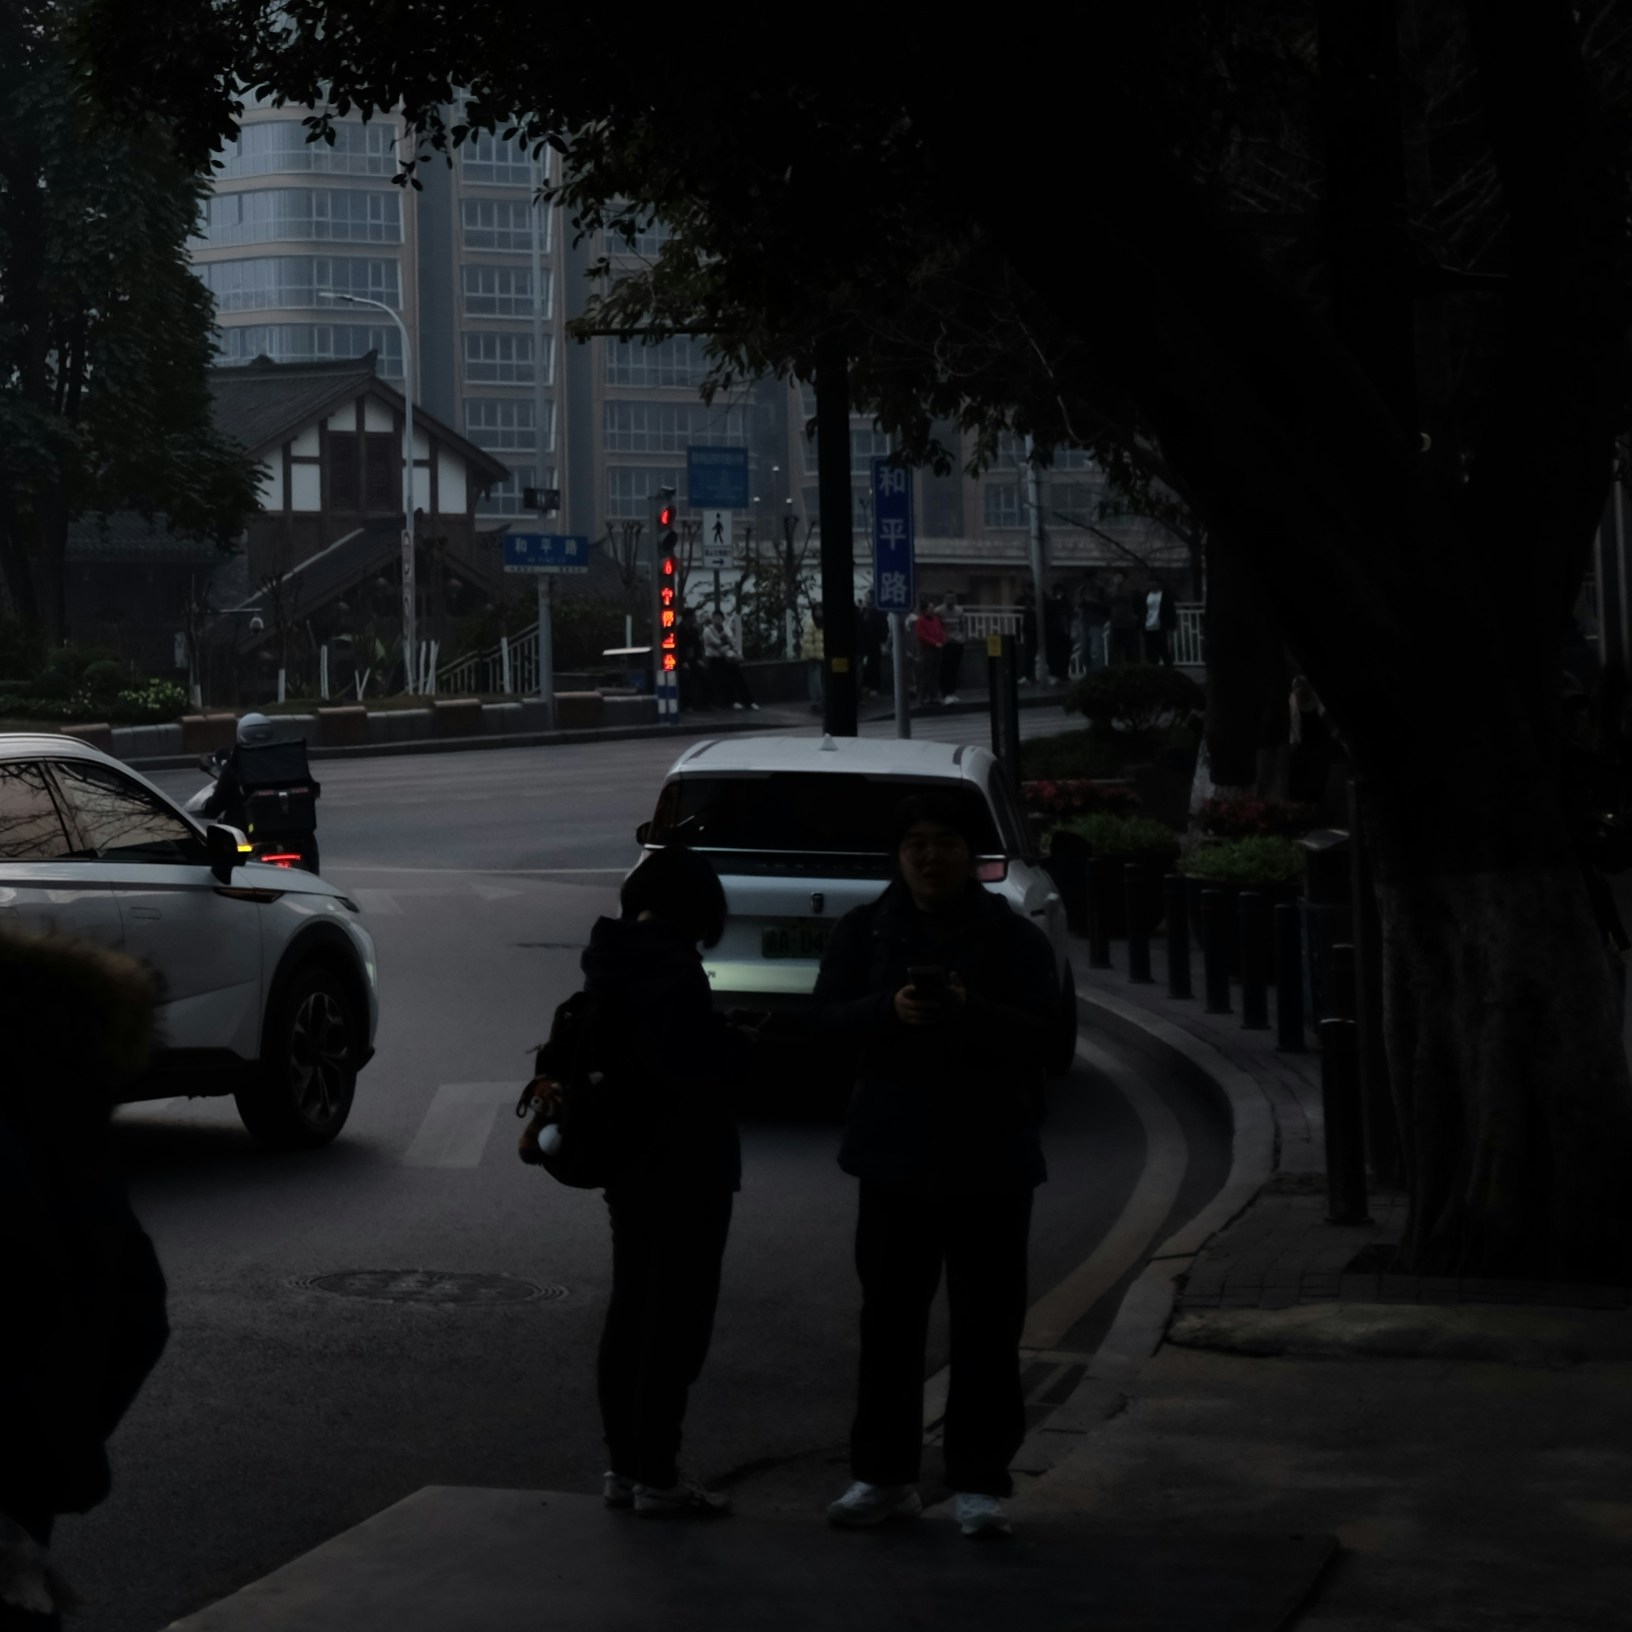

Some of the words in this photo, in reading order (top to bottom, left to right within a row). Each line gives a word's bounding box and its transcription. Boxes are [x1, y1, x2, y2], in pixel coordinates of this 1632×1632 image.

[515, 537, 578, 556] 和平路
[879, 465, 908, 605] 和平路
